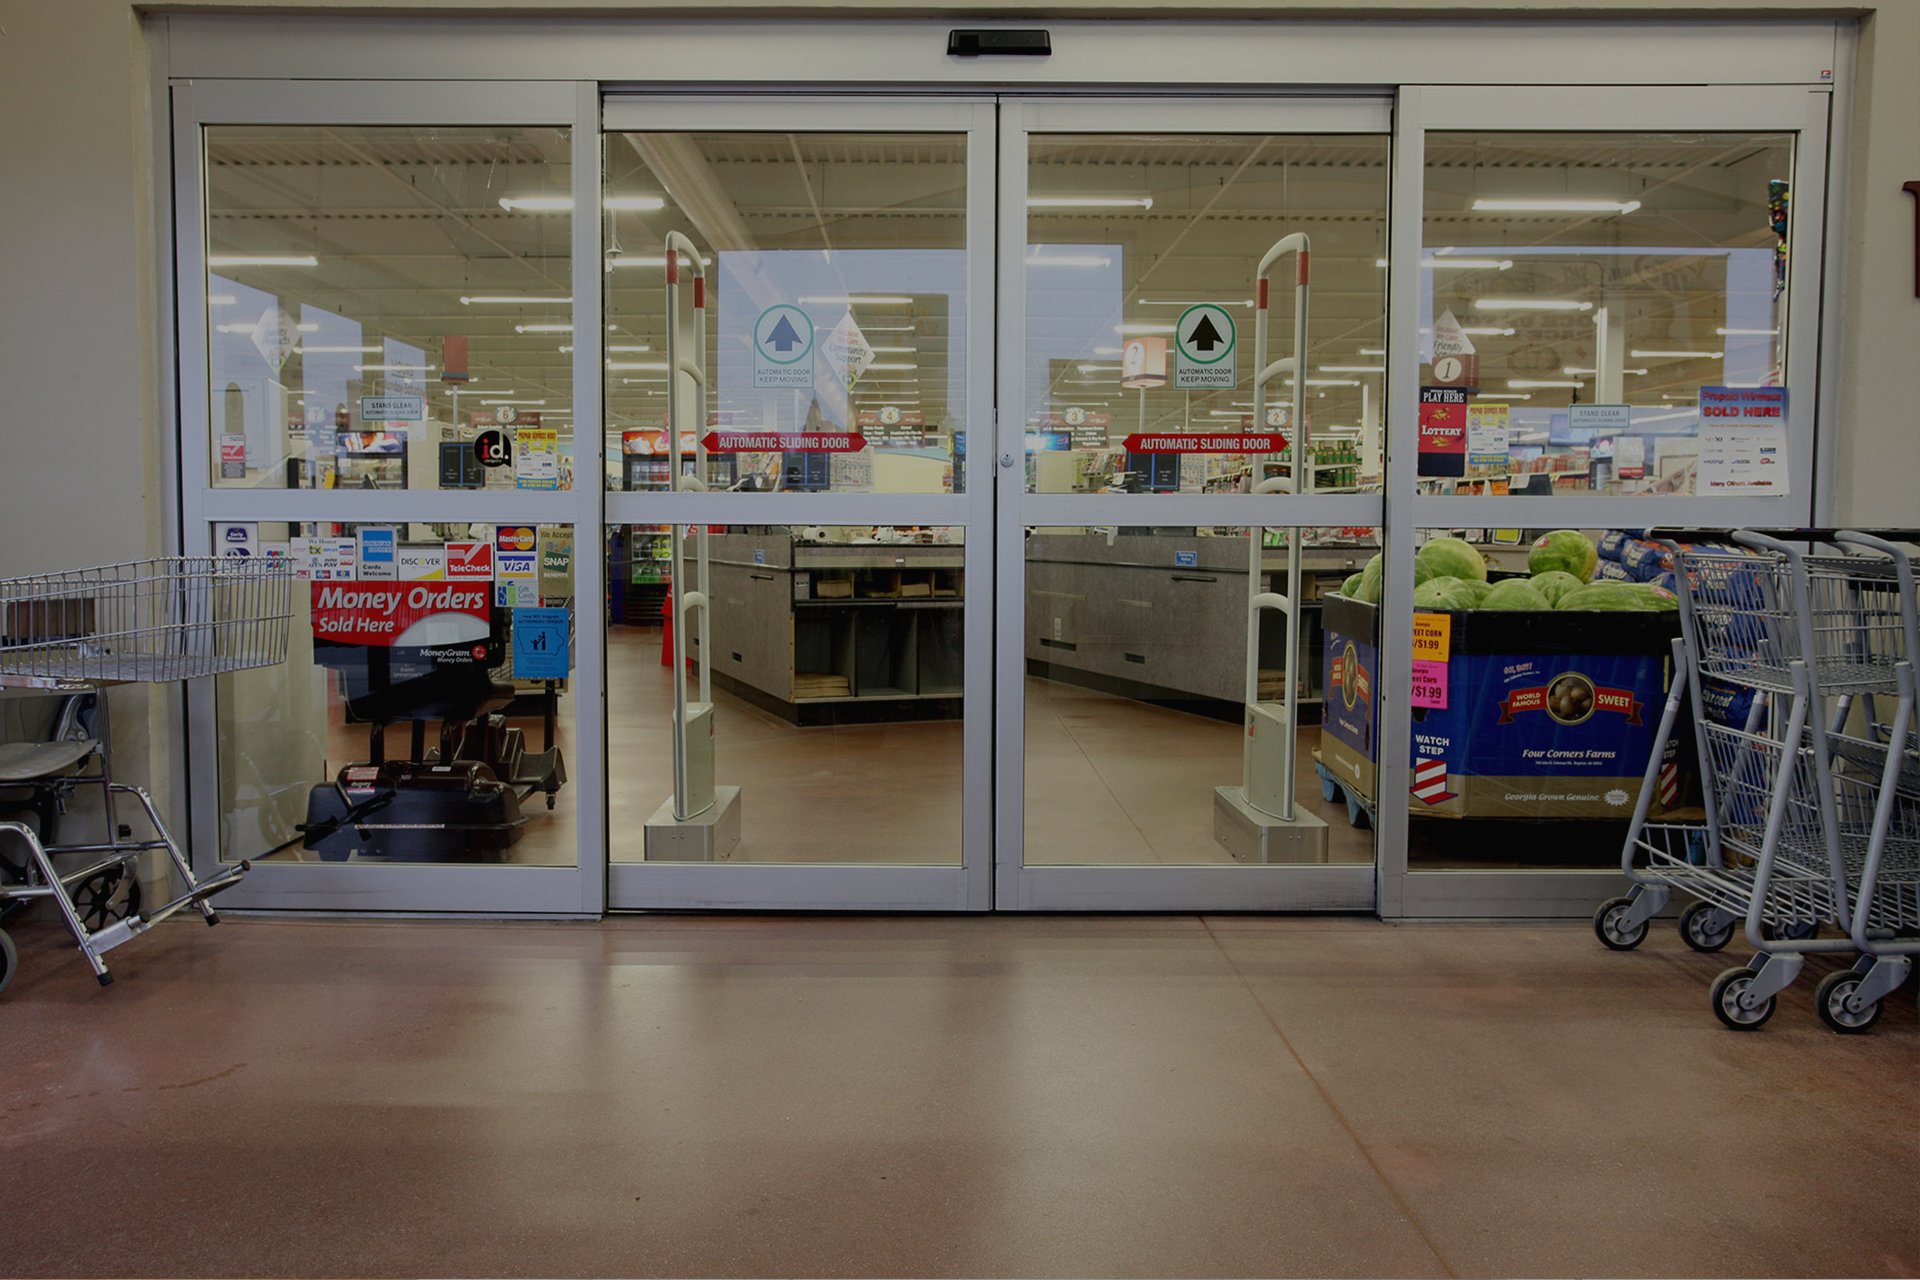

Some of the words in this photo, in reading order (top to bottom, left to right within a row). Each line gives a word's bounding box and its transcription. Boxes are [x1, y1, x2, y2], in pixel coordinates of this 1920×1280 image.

[829, 343, 867, 358] Community
[1434, 340, 1462, 351] Friendly
[835, 352, 862, 364] Support
[1442, 361, 1452, 379] 1
[1423, 392, 1442, 402] PLAY
[1443, 393, 1464, 402] HERE
[1702, 391, 1739, 402] Prepaid
[502, 411, 509, 420] 6
[886, 411, 893, 420] 4
[1071, 412, 1078, 421] 3
[1703, 406, 1739, 417] SOLD
[1743, 406, 1781, 417] HERE
[1272, 413, 1280, 422] 2
[719, 436, 777, 449] AUTOMATIC
[779, 436, 820, 449] SLIDING
[822, 436, 850, 449] DOOR
[1140, 438, 1198, 450] AUTOMATIC
[1200, 438, 1240, 450] SLIDING
[1242, 438, 1271, 450] DOOR
[552, 531, 574, 539] Accept
[401, 557, 441, 565] DISCOVER
[543, 557, 569, 567] SNAP
[449, 564, 492, 572] TeleCheck
[503, 562, 530, 571] VISA
[317, 587, 402, 616] Money
[408, 586, 485, 609] Orders
[318, 616, 353, 633] Sold
[356, 617, 395, 633] Here
[1426, 629, 1442, 637] CORN
[419, 649, 471, 659] MoneyGram
[1423, 675, 1438, 683] Corn
[1516, 692, 1541, 700] WORLD
[1598, 694, 1630, 707] SWEET
[1512, 698, 1541, 708] FAMOUS
[1415, 734, 1450, 747] WATCH
[1418, 745, 1445, 756] STEP
[1522, 749, 1545, 759] Four
[1546, 749, 1584, 759] Corners
[1586, 749, 1617, 759] Farms
[1504, 793, 1537, 802] Georgia
